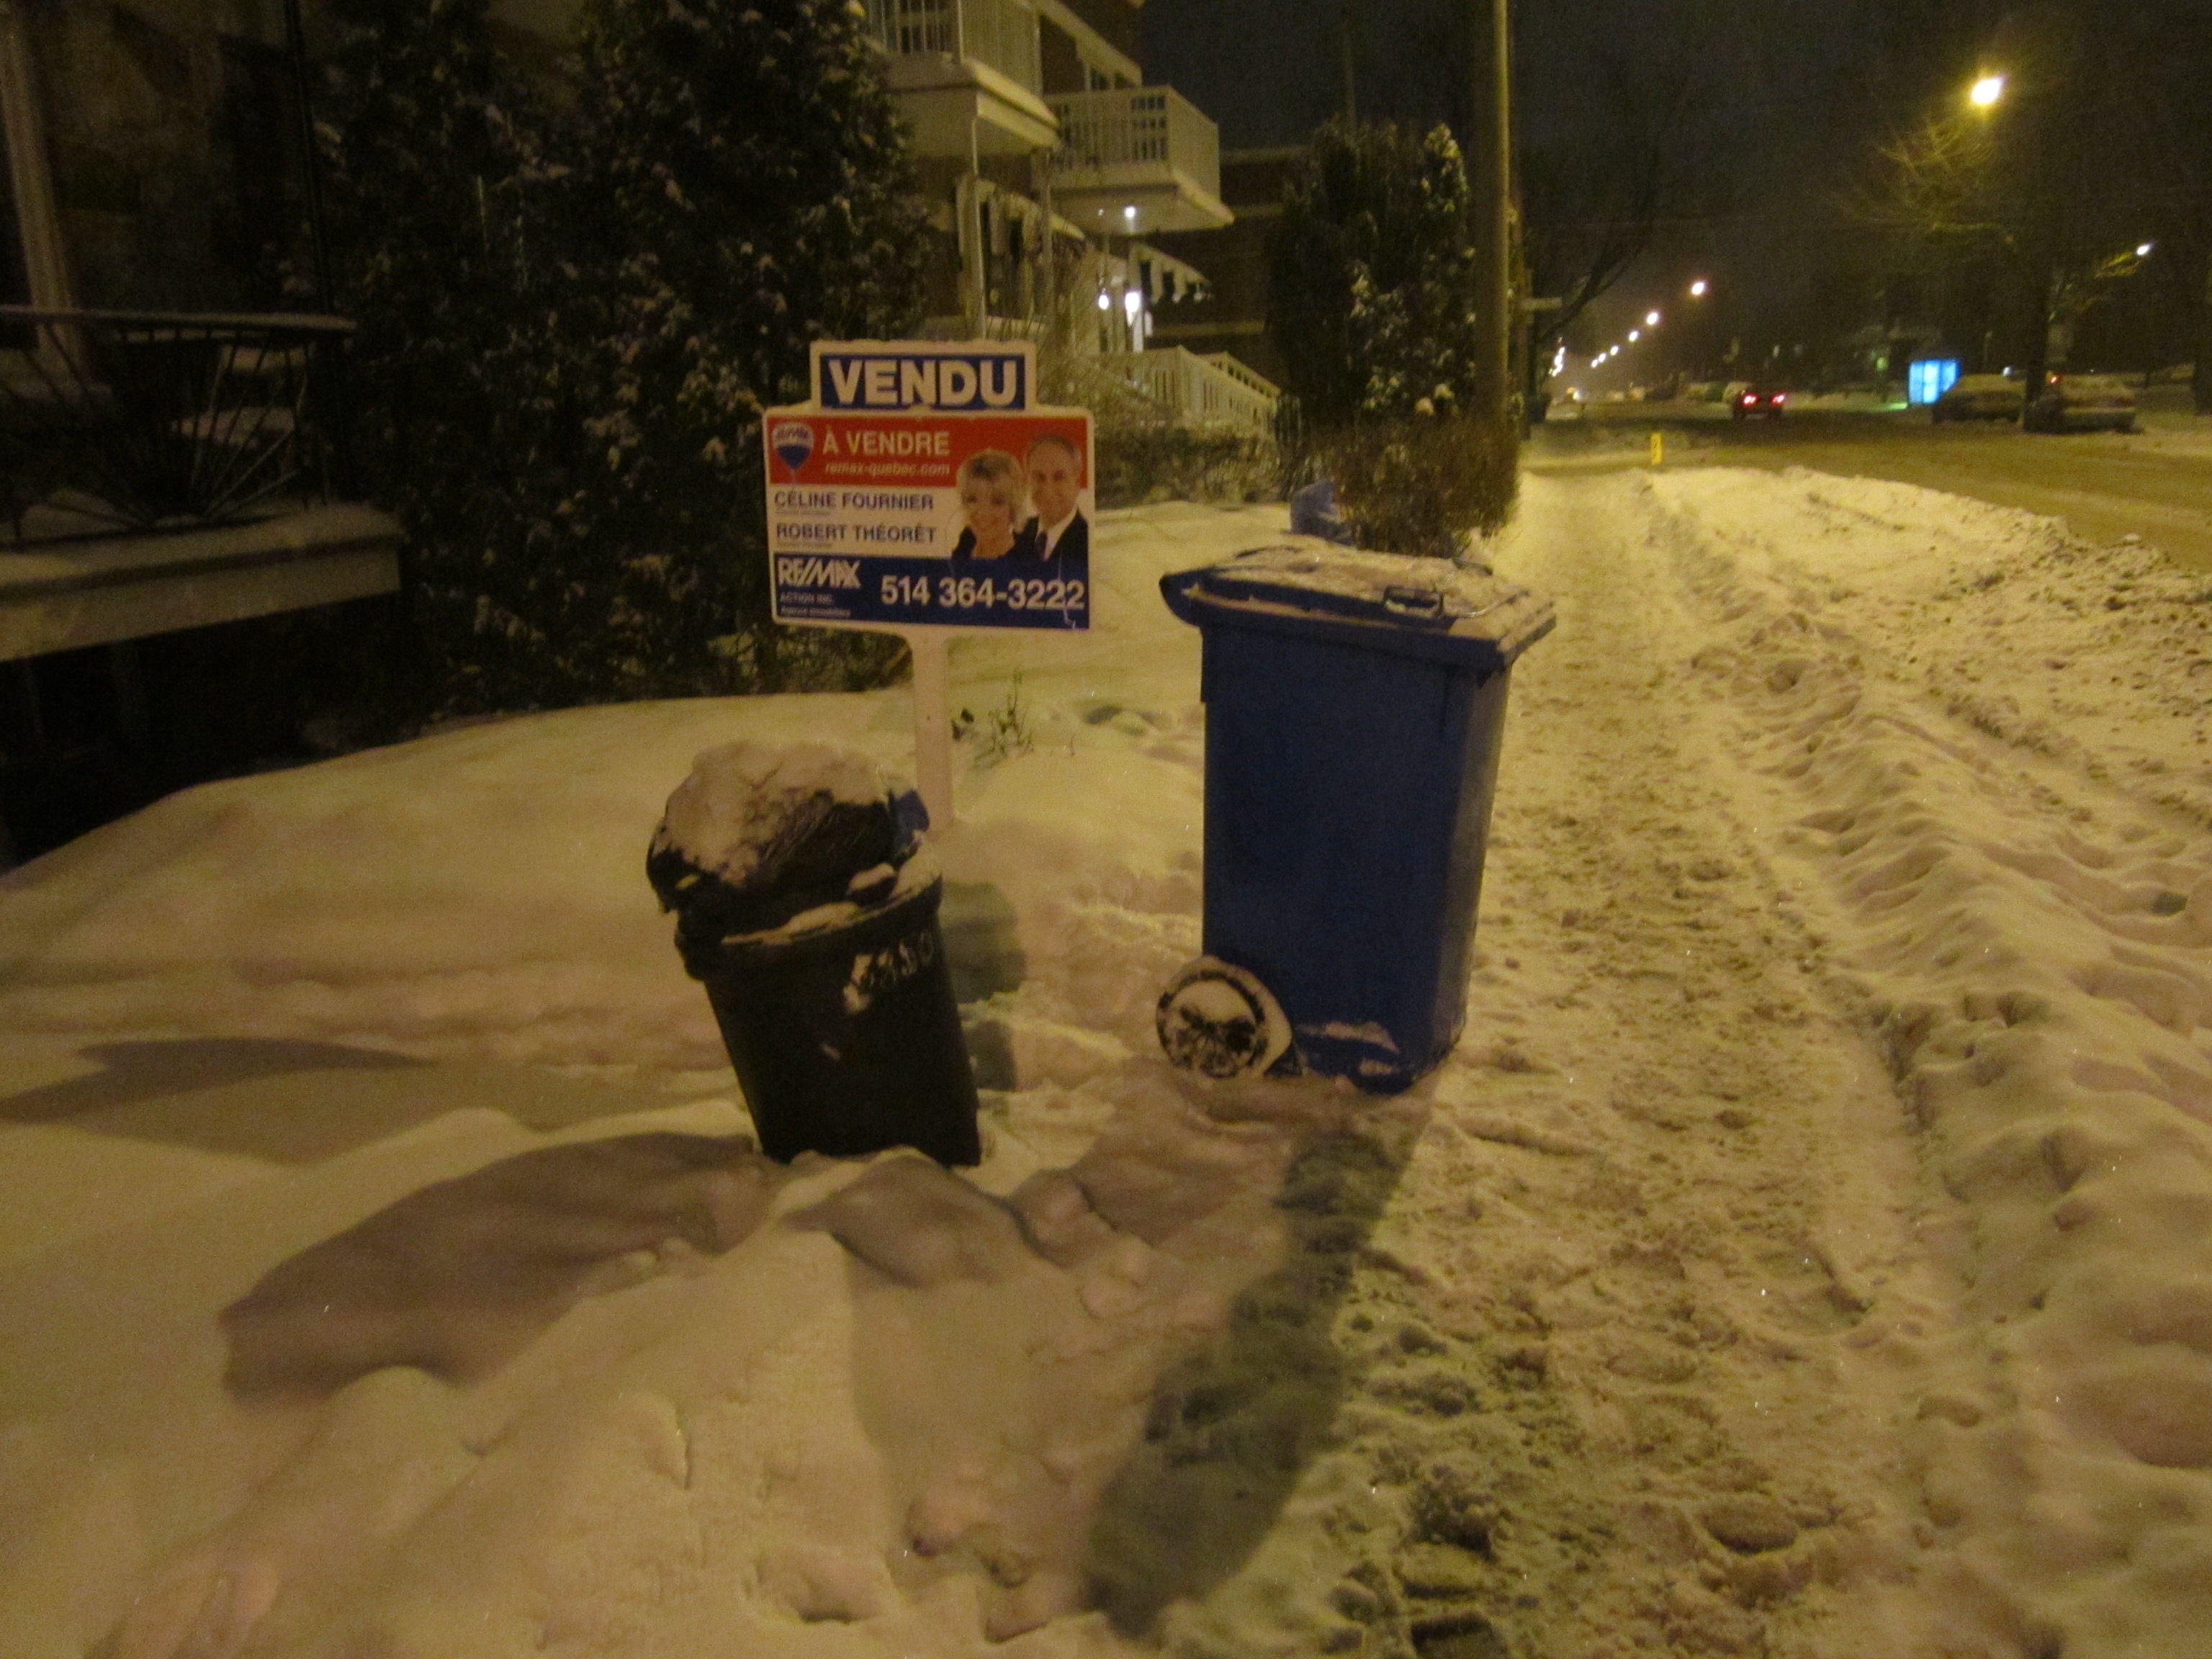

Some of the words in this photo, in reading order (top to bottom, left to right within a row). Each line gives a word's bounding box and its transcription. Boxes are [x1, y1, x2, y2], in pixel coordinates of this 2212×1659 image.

[828, 359, 1017, 408] VENDU
[822, 423, 840, 456] À
[845, 430, 950, 457] VENDRE
[774, 487, 837, 507] CÉLINE
[842, 493, 934, 511] FOURNIER
[776, 523, 847, 541] ROBERT
[778, 557, 861, 589] RE/MAX
[881, 575, 930, 606] 514
[938, 577, 1085, 611] 364-3222
